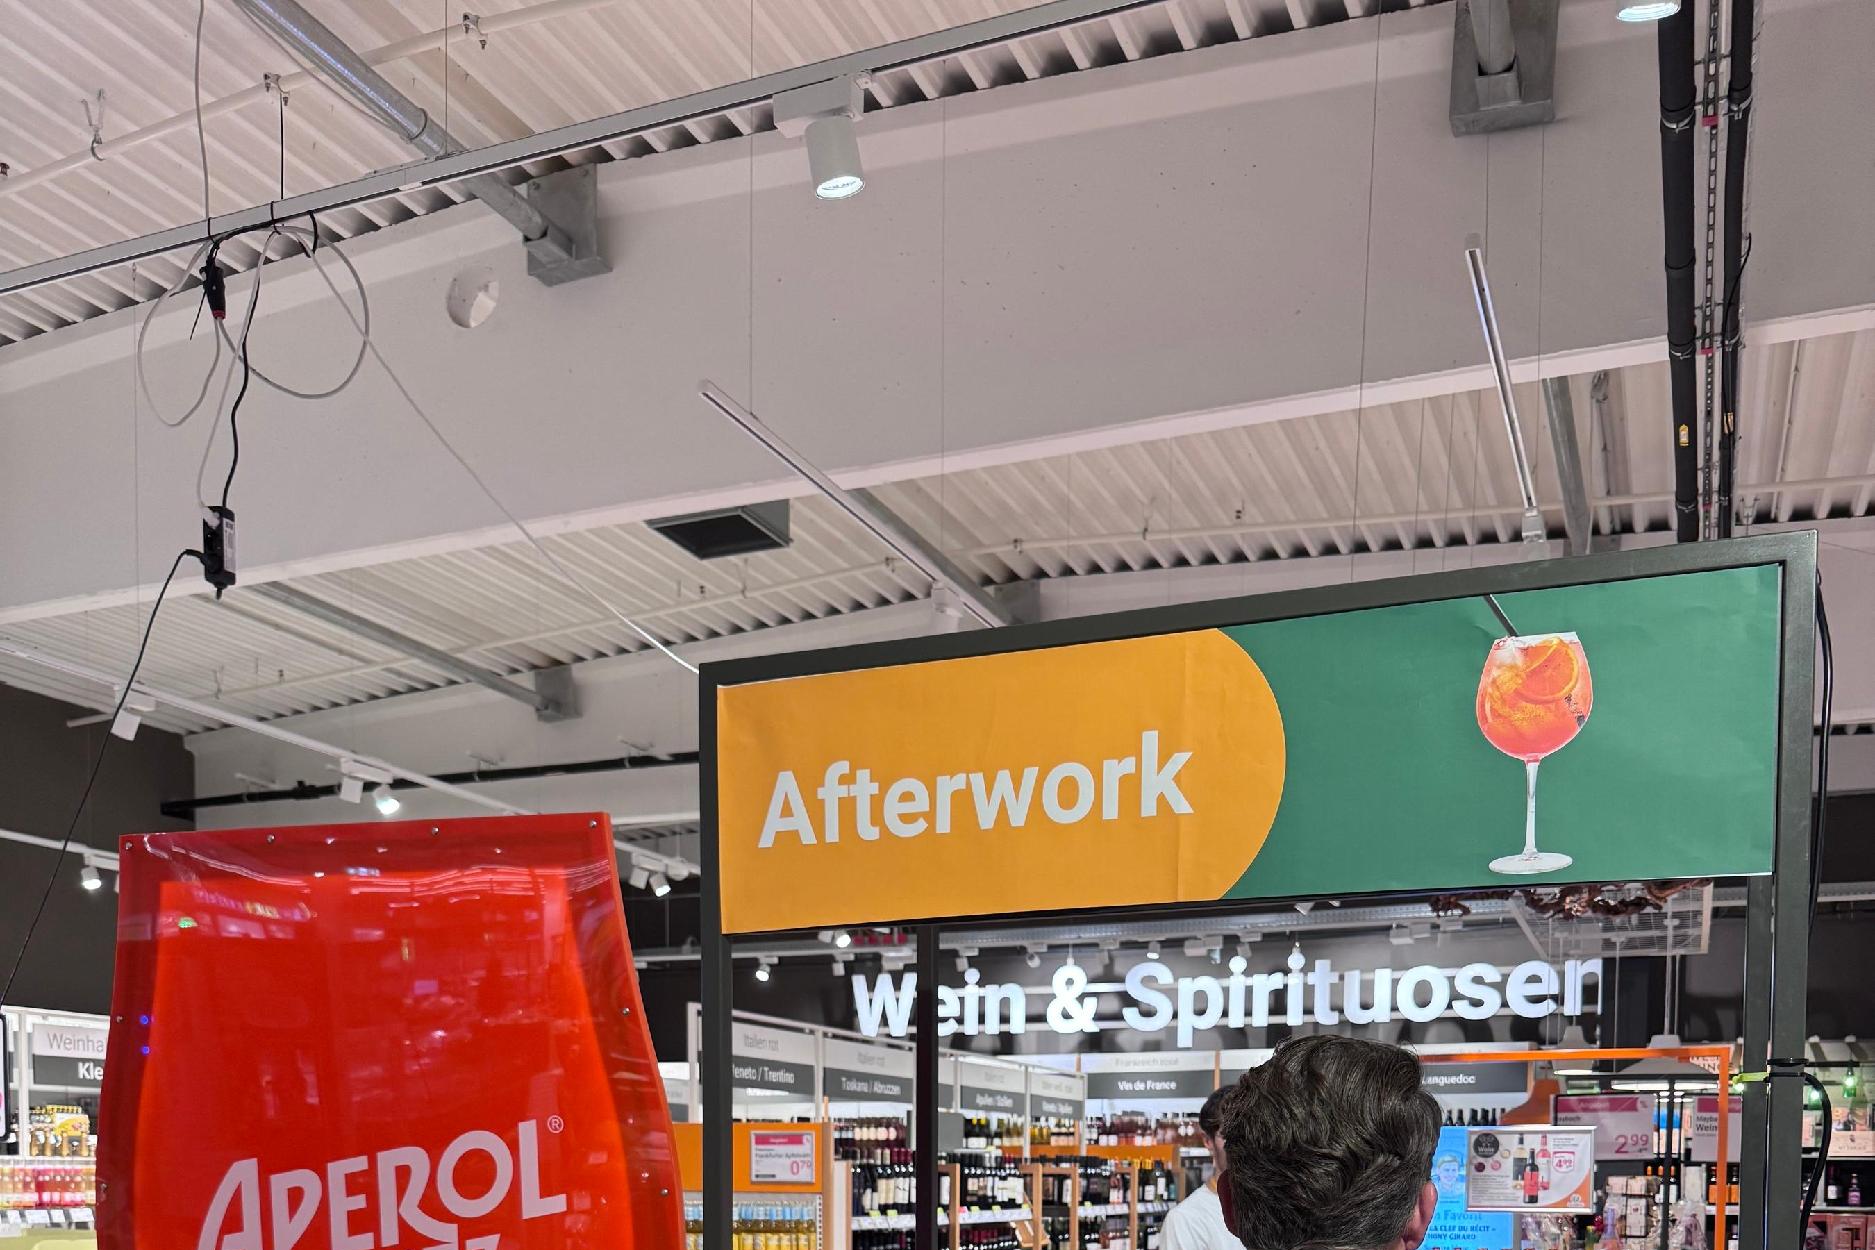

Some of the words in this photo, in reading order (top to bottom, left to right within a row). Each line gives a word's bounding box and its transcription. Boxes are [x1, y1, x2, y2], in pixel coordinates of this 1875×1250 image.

[758, 731, 1194, 848] Afterwork
[853, 968, 1026, 1038] Wein
[1046, 964, 1099, 1034] &
[1147, 1079, 1177, 1090] France
